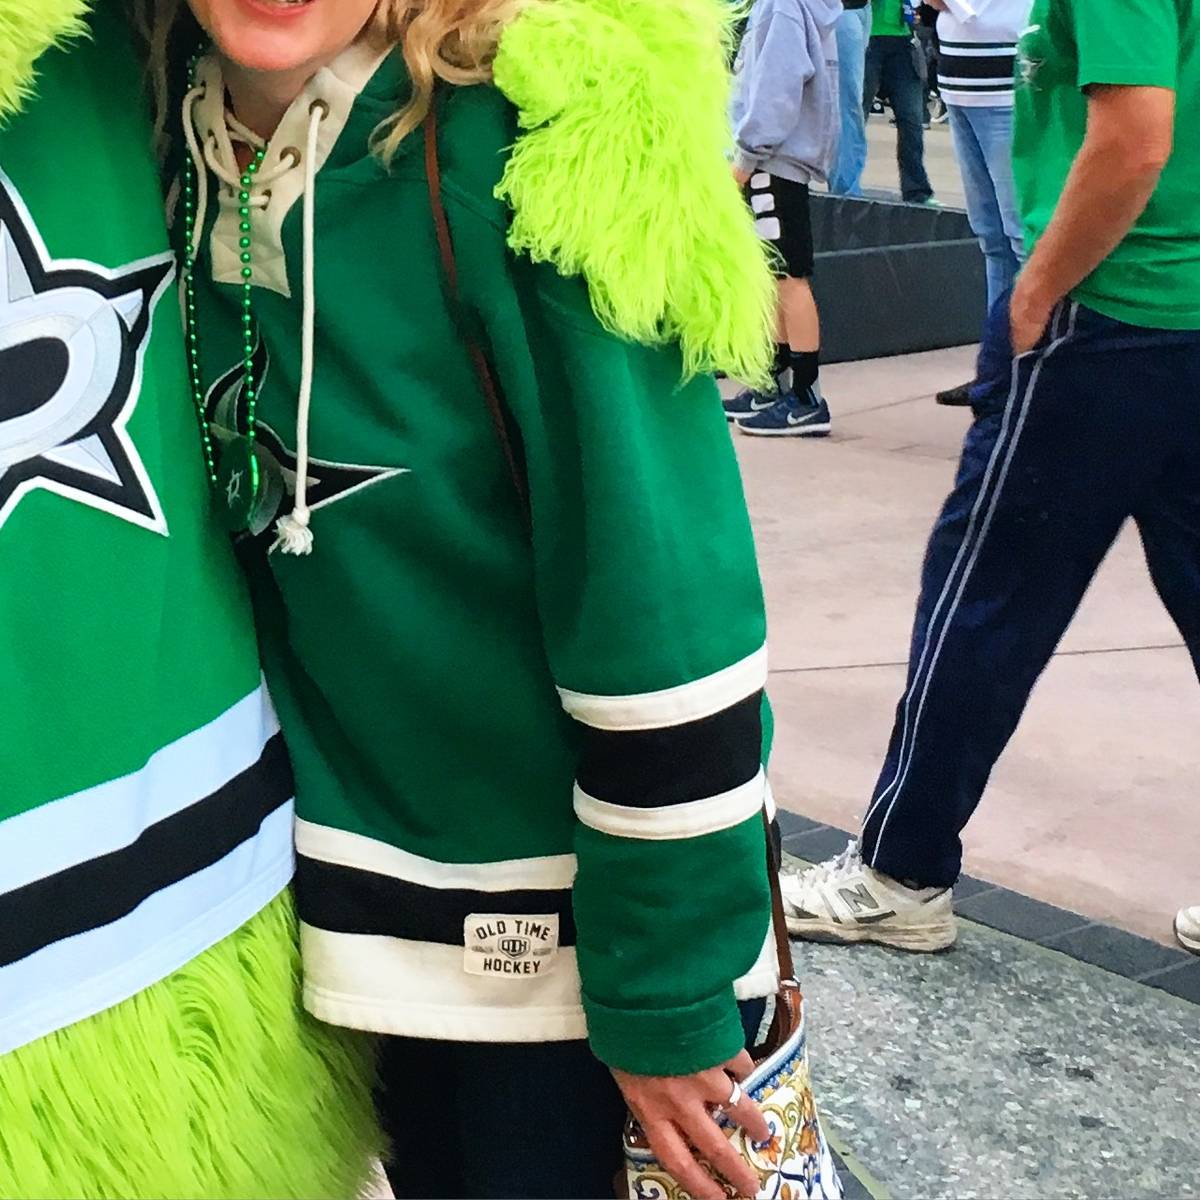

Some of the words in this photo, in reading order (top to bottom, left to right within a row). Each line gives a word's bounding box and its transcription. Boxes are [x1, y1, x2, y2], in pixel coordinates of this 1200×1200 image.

[475, 920, 506, 940] OLD
[515, 920, 551, 941] TIME
[483, 958, 541, 974] HOCKEY
